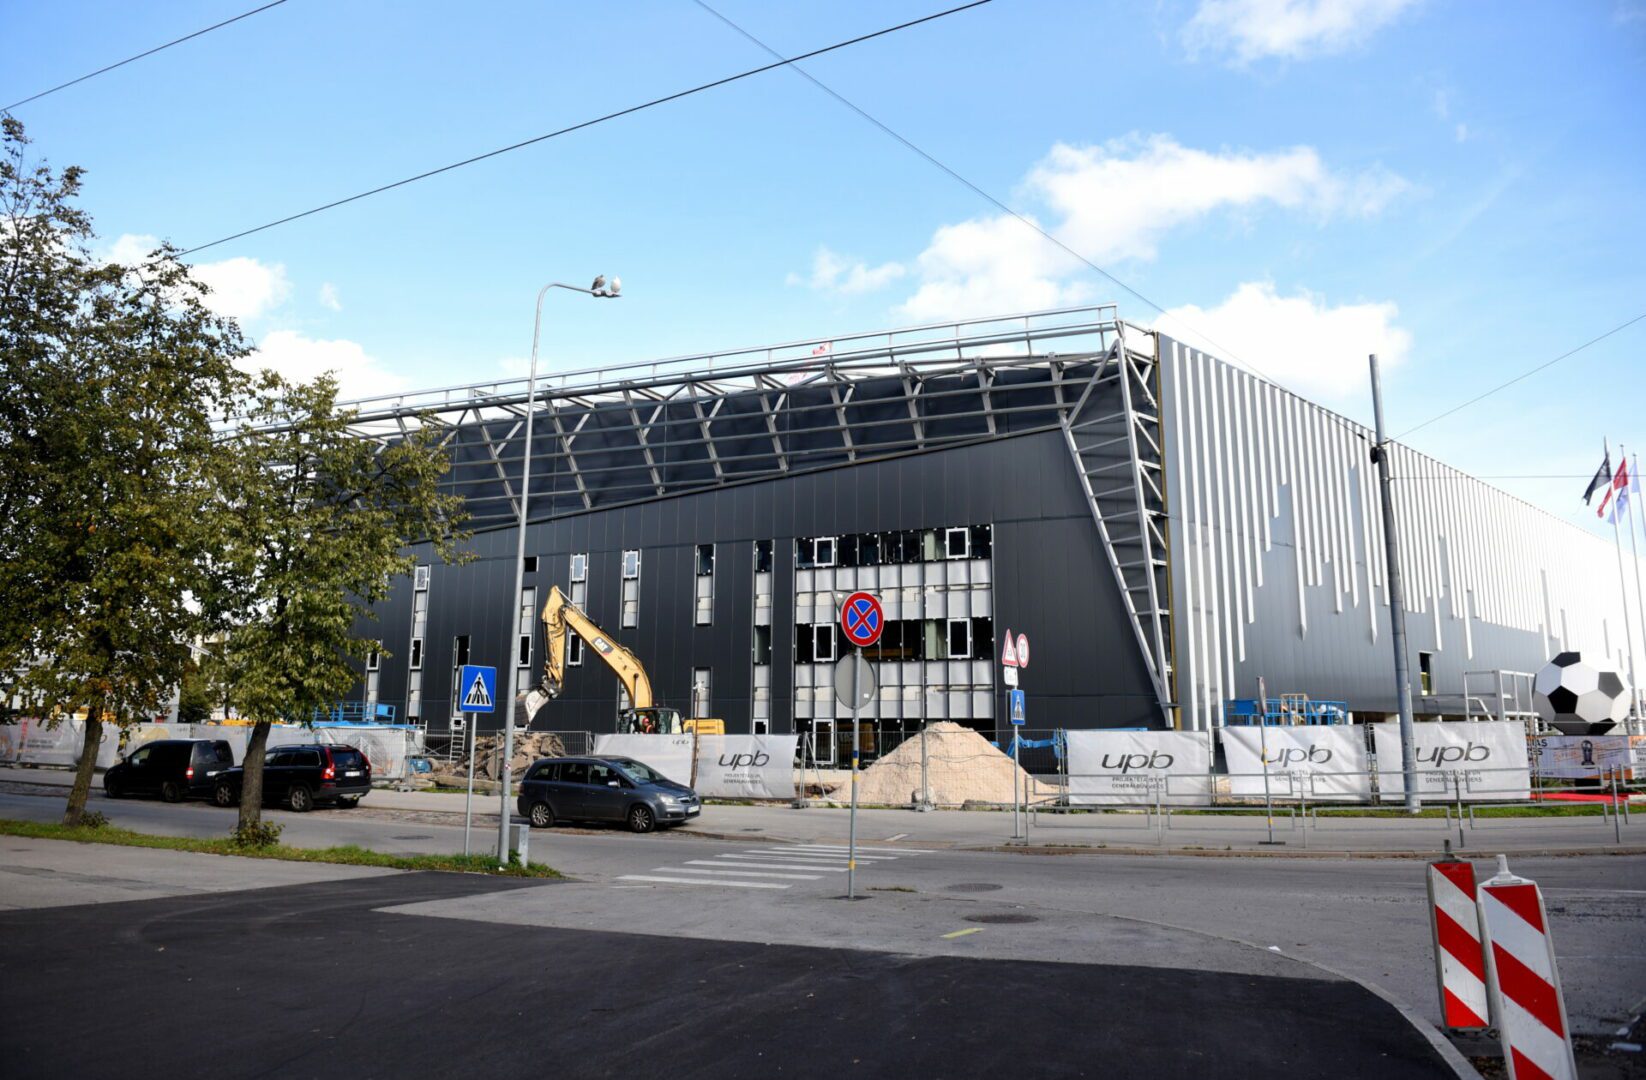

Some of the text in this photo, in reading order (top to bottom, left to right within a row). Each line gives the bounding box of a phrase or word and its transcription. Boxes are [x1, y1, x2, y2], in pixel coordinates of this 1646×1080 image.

[718, 750, 770, 771] upb
[1101, 750, 1174, 774] upb
[1261, 744, 1333, 768] upb
[1415, 742, 1490, 768] upb
